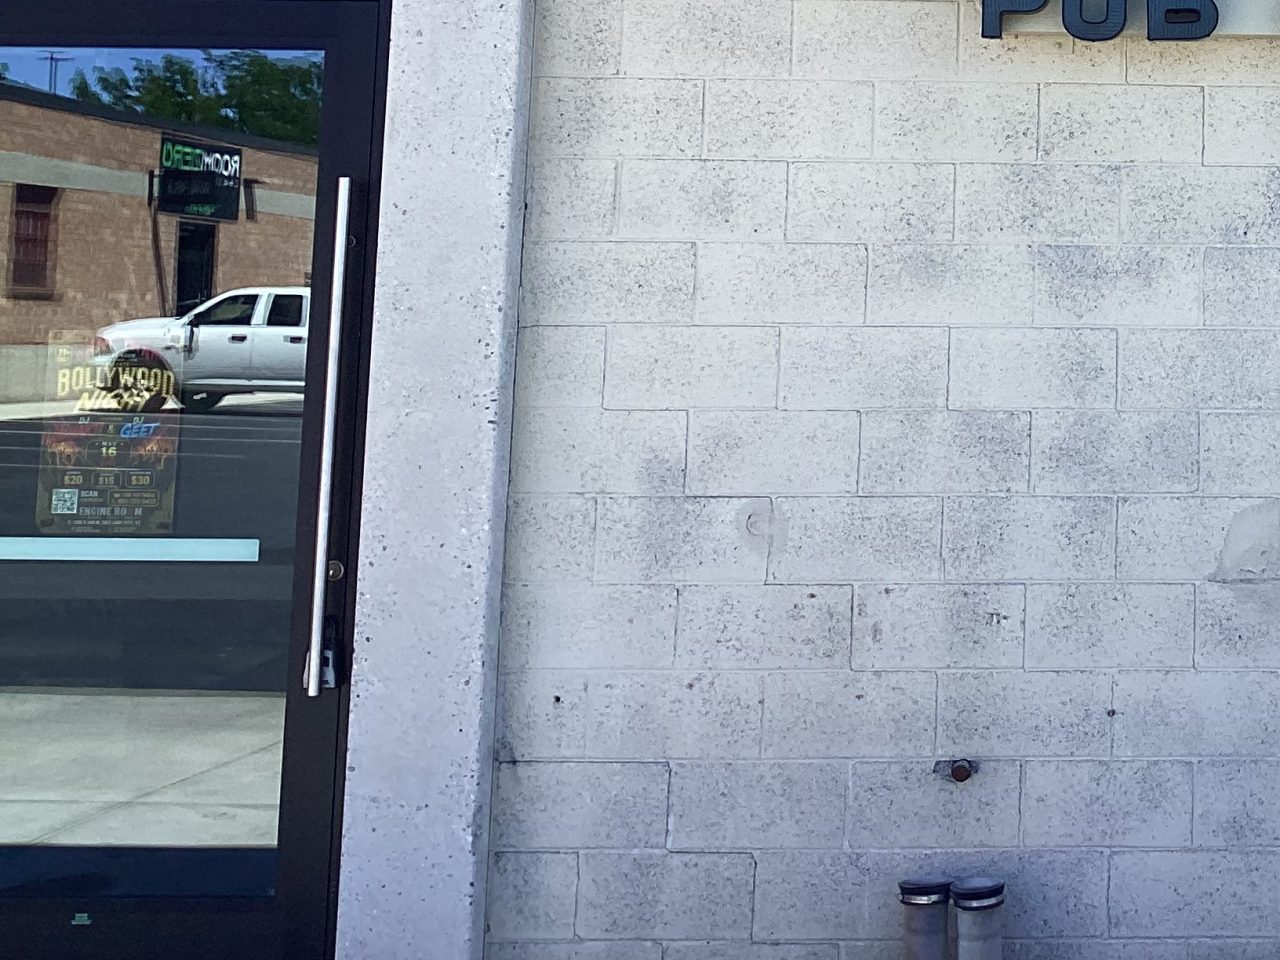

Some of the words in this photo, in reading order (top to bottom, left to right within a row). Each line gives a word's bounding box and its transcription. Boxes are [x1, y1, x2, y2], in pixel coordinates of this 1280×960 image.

[57, 366, 176, 398] BOLLYWOOD
[120, 423, 161, 438] GEET
[100, 446, 118, 457] 16
[80, 507, 112, 516] ENGINE
